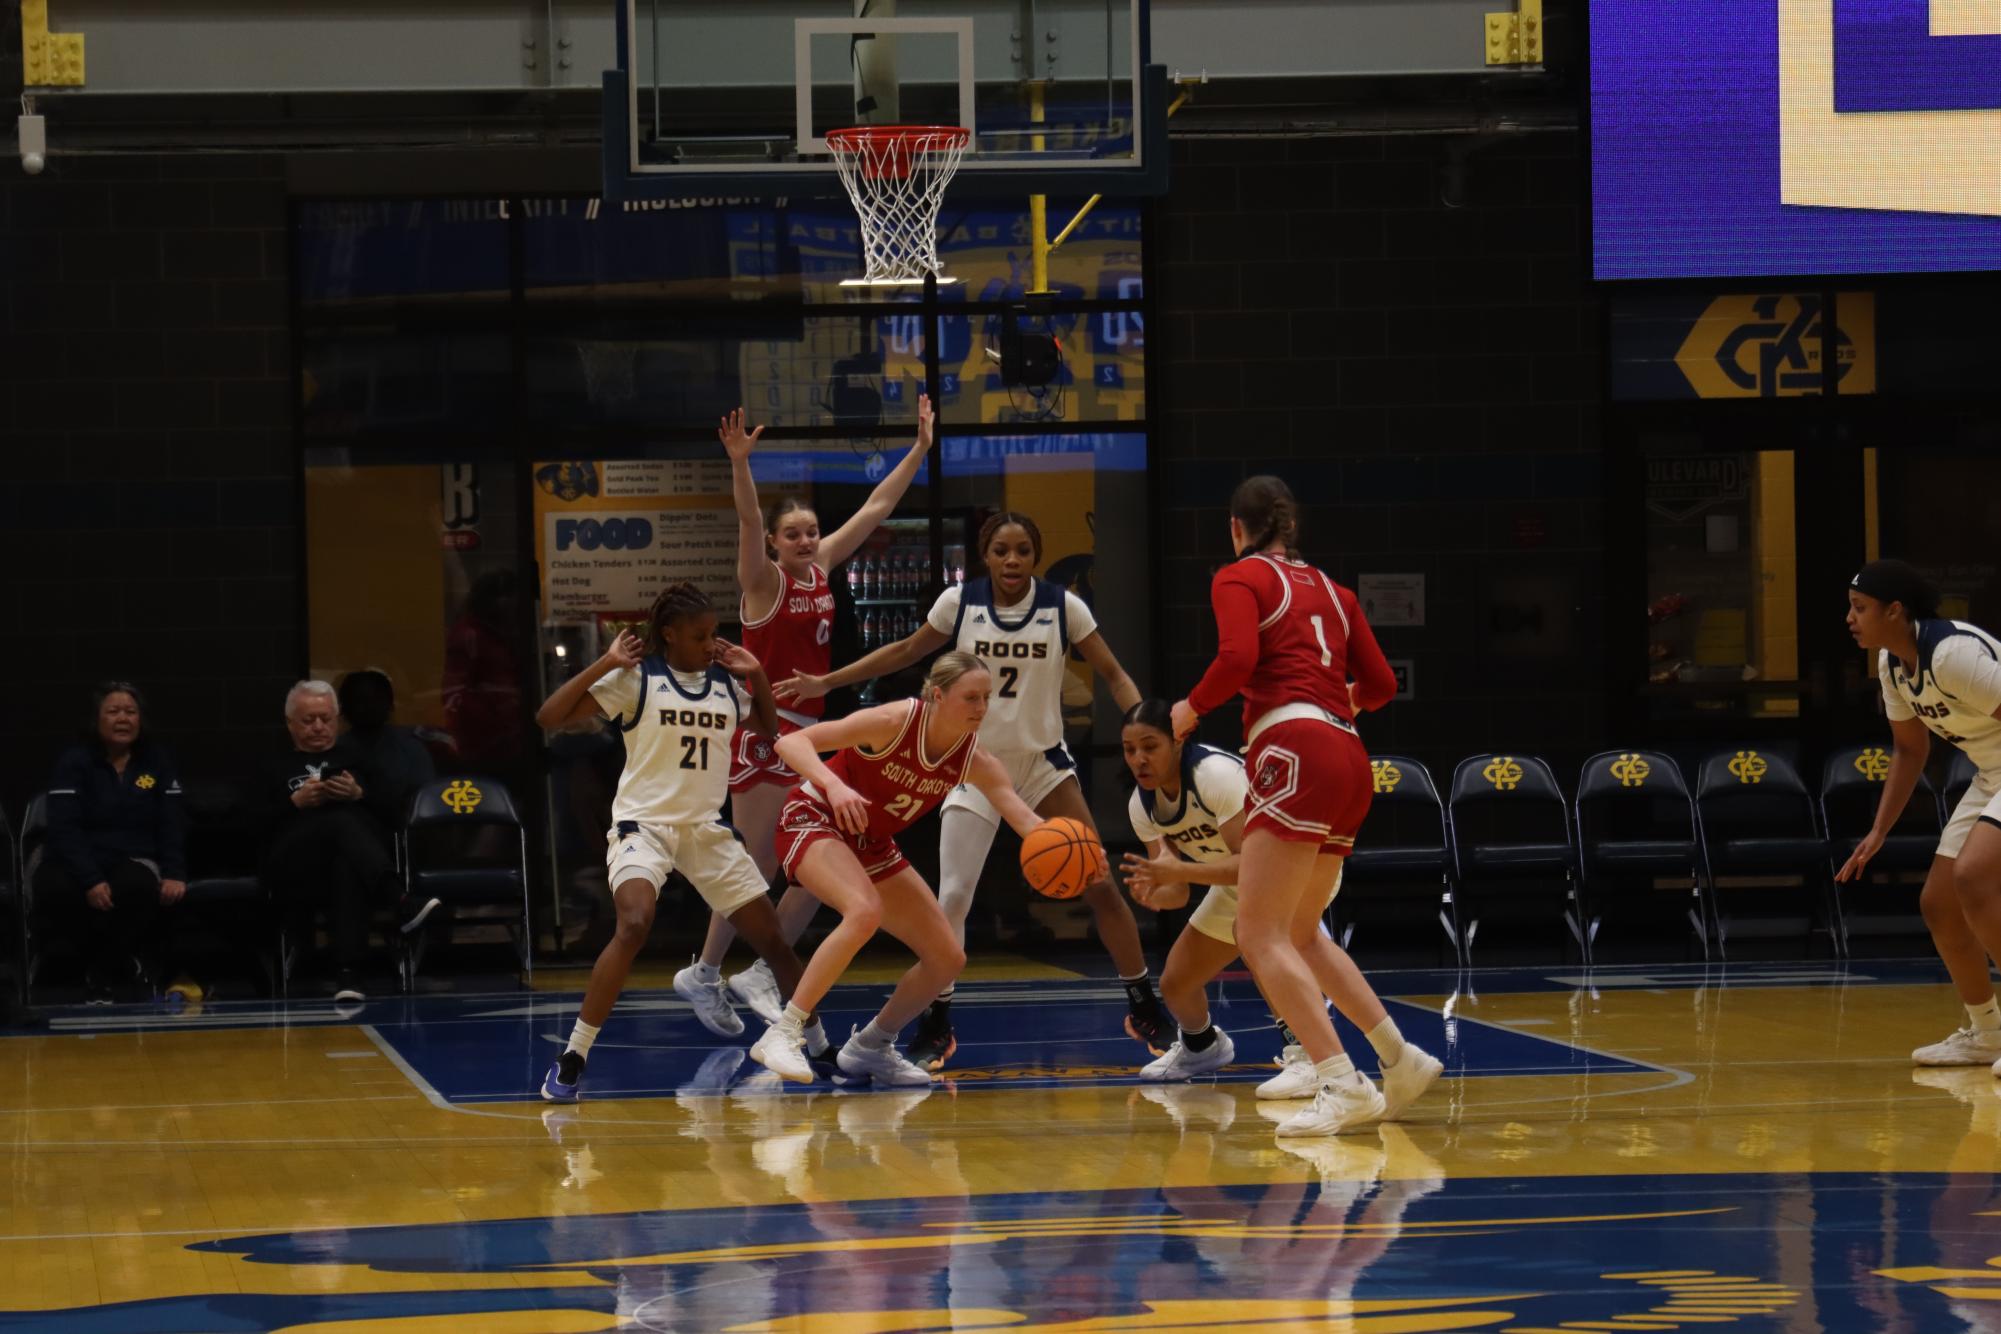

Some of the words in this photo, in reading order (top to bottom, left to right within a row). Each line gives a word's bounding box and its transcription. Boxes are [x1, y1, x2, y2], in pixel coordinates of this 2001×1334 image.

[556, 517, 653, 551] FOOD
[660, 541, 682, 549] Sour
[684, 540, 713, 549] Patch
[551, 560, 591, 568] Chicken
[593, 560, 632, 568] Tenders
[660, 559, 704, 567] Assorted
[706, 559, 735, 568] Candy
[552, 577, 570, 586] Hot
[572, 577, 591, 586] Dog
[552, 592, 608, 602] Hamburger
[975, 640, 1048, 659] ROOS
[1310, 614, 1333, 668] 1
[999, 666, 1018, 698] 2
[659, 709, 727, 730] ROOS
[679, 736, 709, 771] 21
[881, 762, 919, 790] SOUTH
[883, 793, 924, 822] 21
